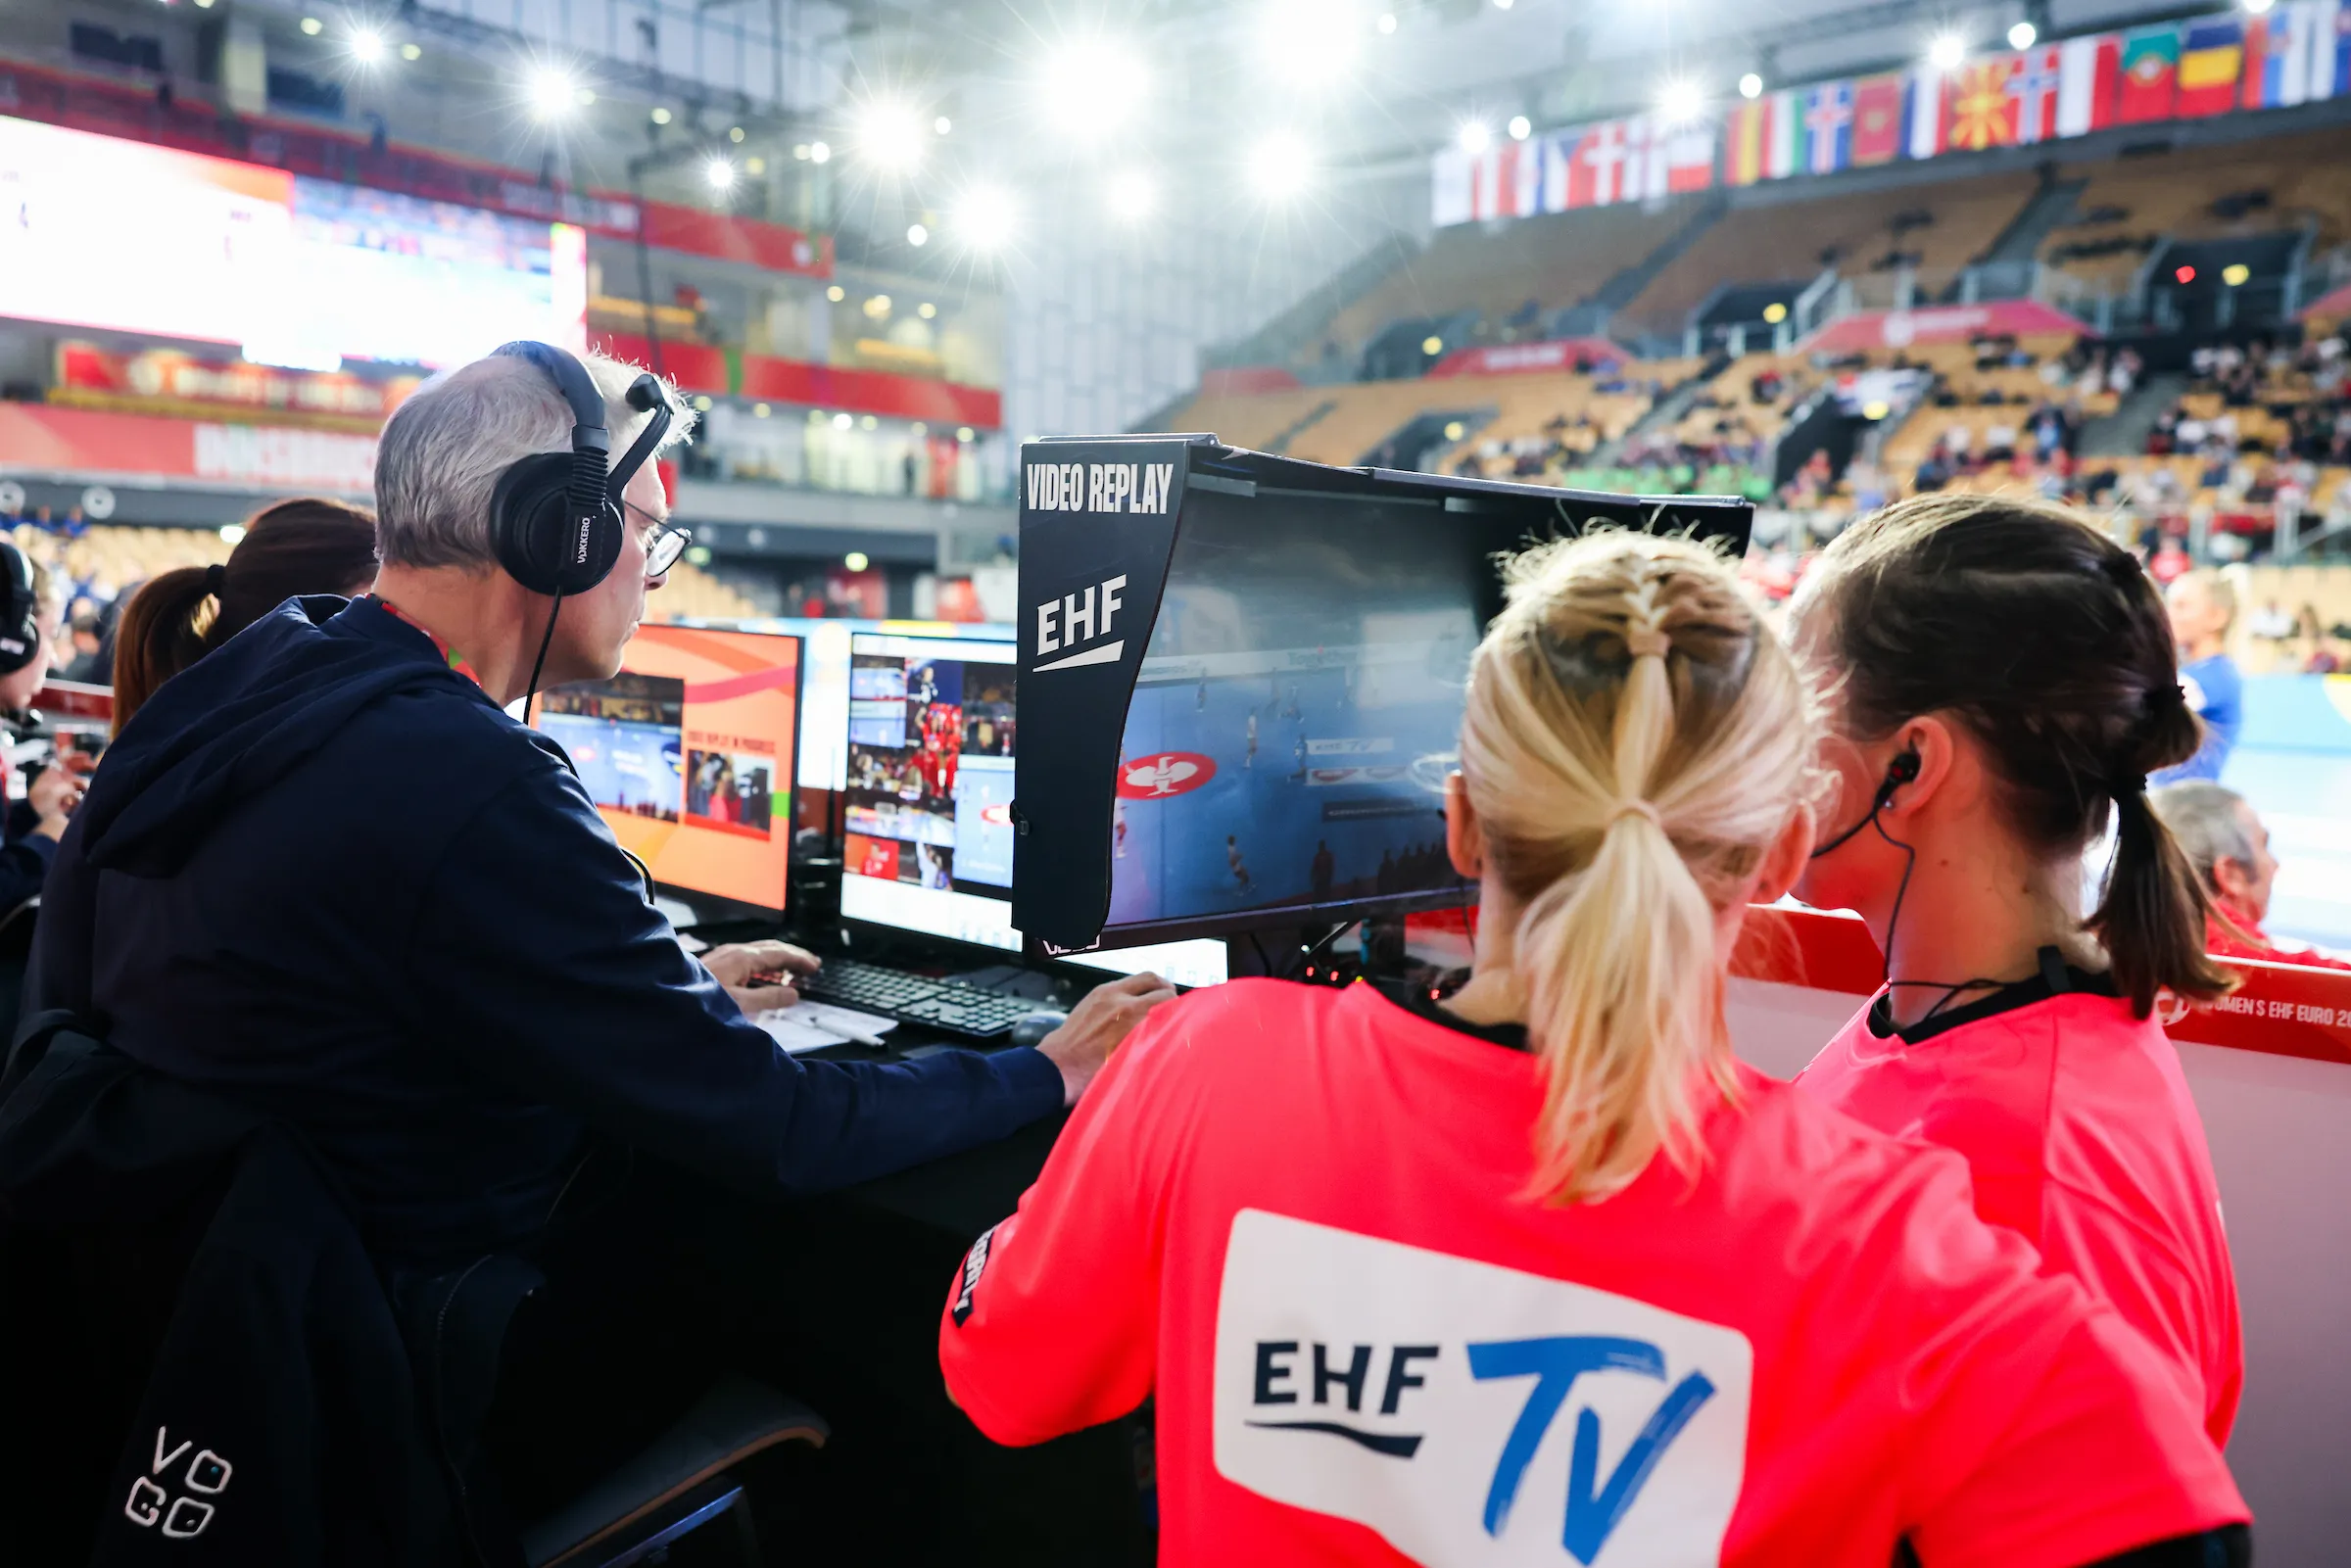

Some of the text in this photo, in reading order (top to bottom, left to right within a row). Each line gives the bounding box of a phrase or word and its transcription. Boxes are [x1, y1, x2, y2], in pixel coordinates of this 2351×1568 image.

[1027, 462, 1174, 514] VIDEO REPLAY
[577, 516, 591, 564] VOKKERO
[1036, 573, 1127, 657] EHF
[2268, 1000, 2294, 1021] EHF
[2296, 1004, 2334, 1026] EURO
[1253, 1334, 1718, 1568] EHF TV
